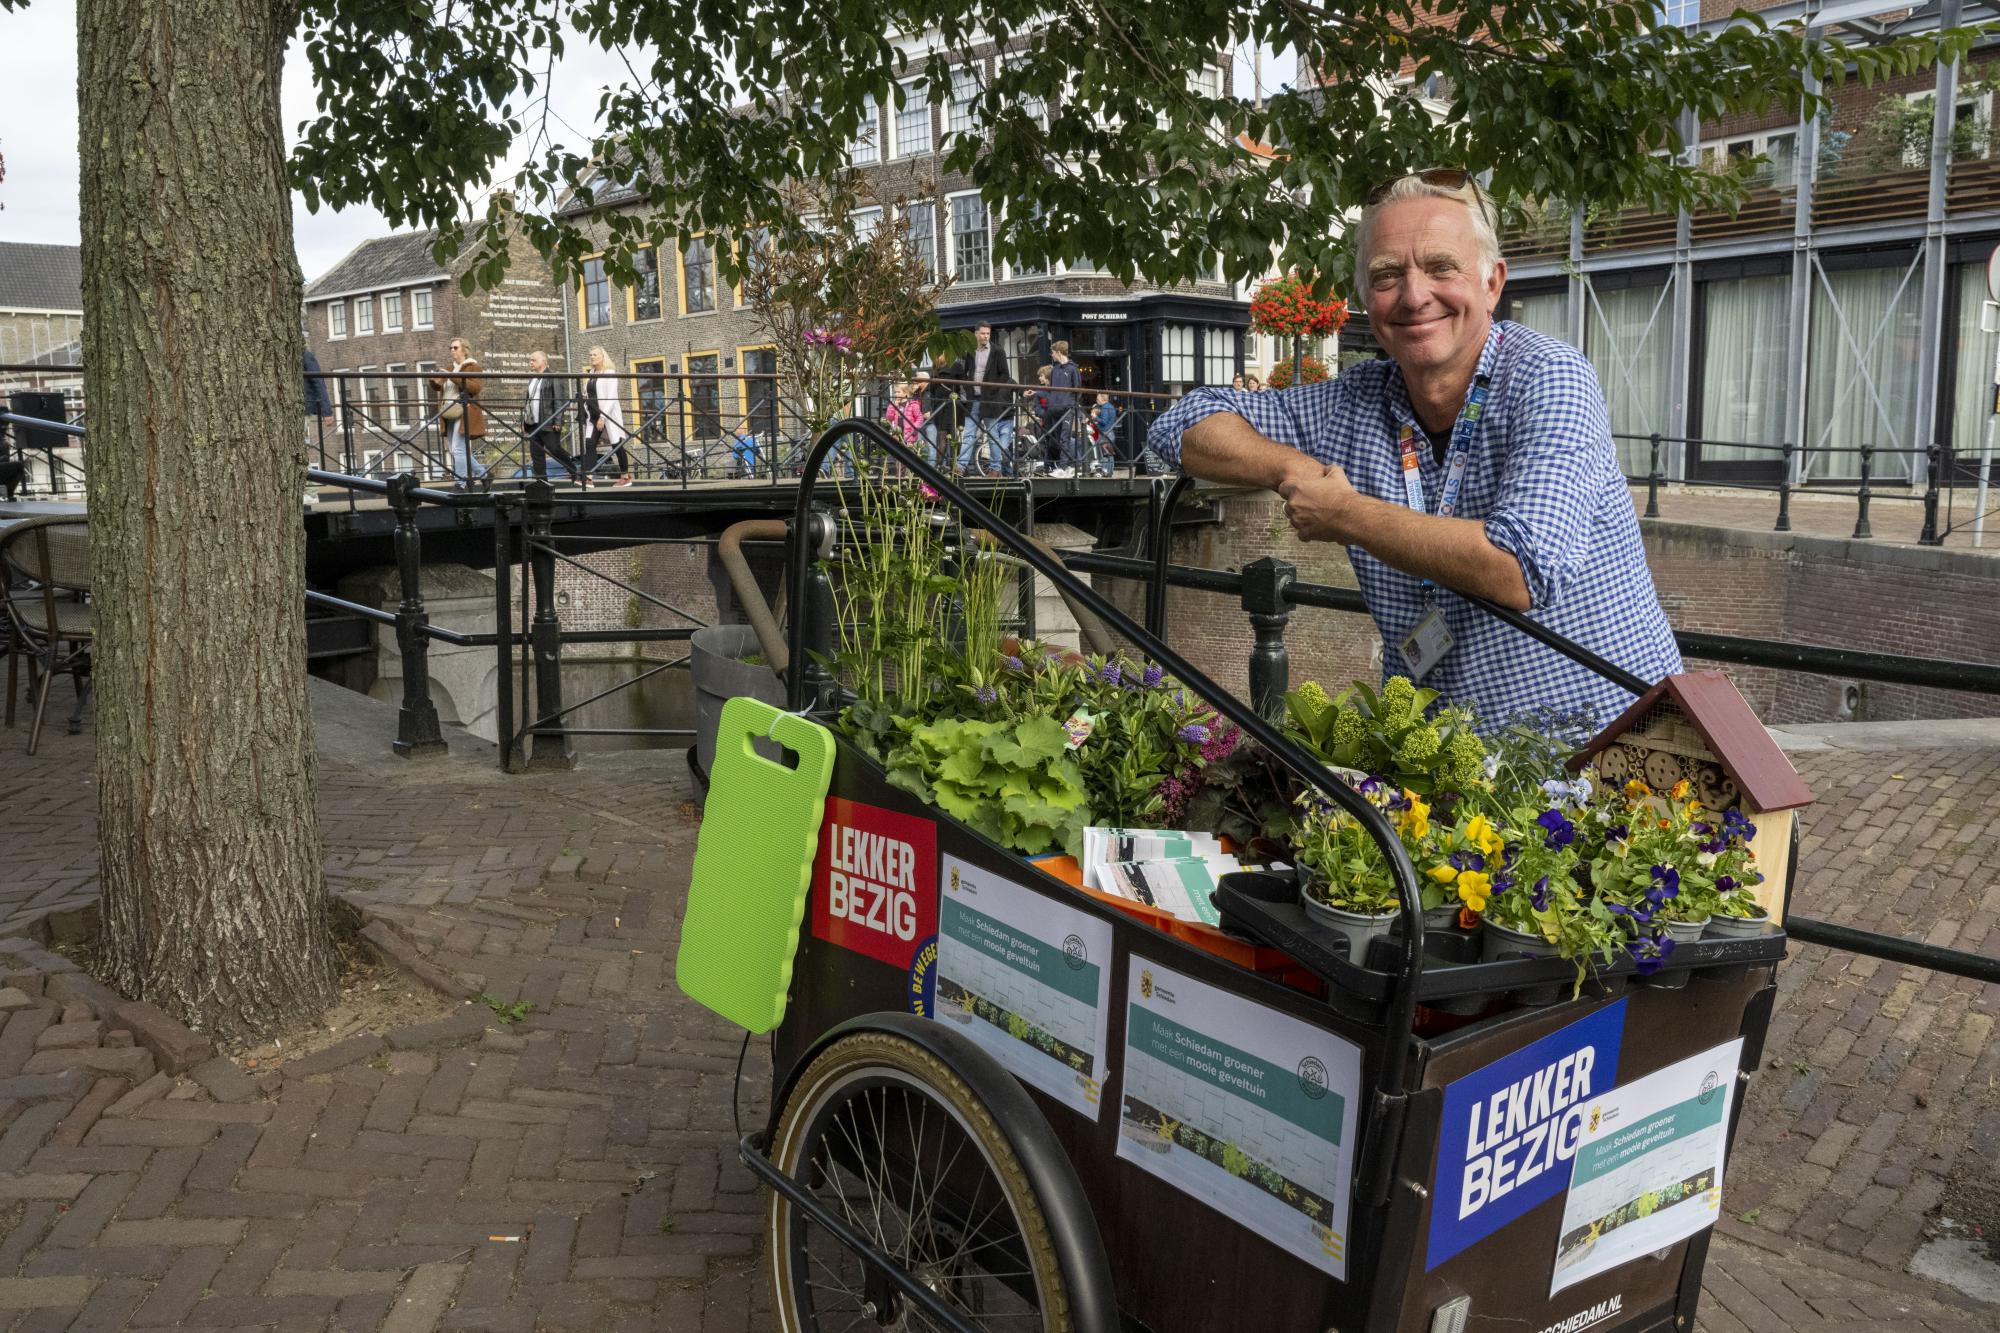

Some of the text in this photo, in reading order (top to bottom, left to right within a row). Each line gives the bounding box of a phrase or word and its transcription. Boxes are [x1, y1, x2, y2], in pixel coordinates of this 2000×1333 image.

[1440, 478, 1460, 516] OALS
[831, 823, 916, 892] LEKKER
[829, 870, 917, 941] BEZIG
[976, 919, 1010, 942] Schiedam
[1010, 937, 1039, 957] groener
[984, 938, 1006, 955] mooie
[1006, 950, 1040, 973] geveltuin
[1151, 1039, 1266, 1098] met een mooie geveltuin
[1152, 1022, 1264, 1080] Maak Schiedam groener
[1466, 1045, 1596, 1162] LEKKER
[1592, 1160, 1607, 1173] met
[1620, 1142, 1642, 1158] mooie
[1641, 1127, 1675, 1150] geveltuin
[1595, 1114, 1676, 1157] Maak Schiedam groener
[1458, 1102, 1585, 1222] BEZIG
[1537, 1294, 1623, 1333] CHIEDAM.NL
